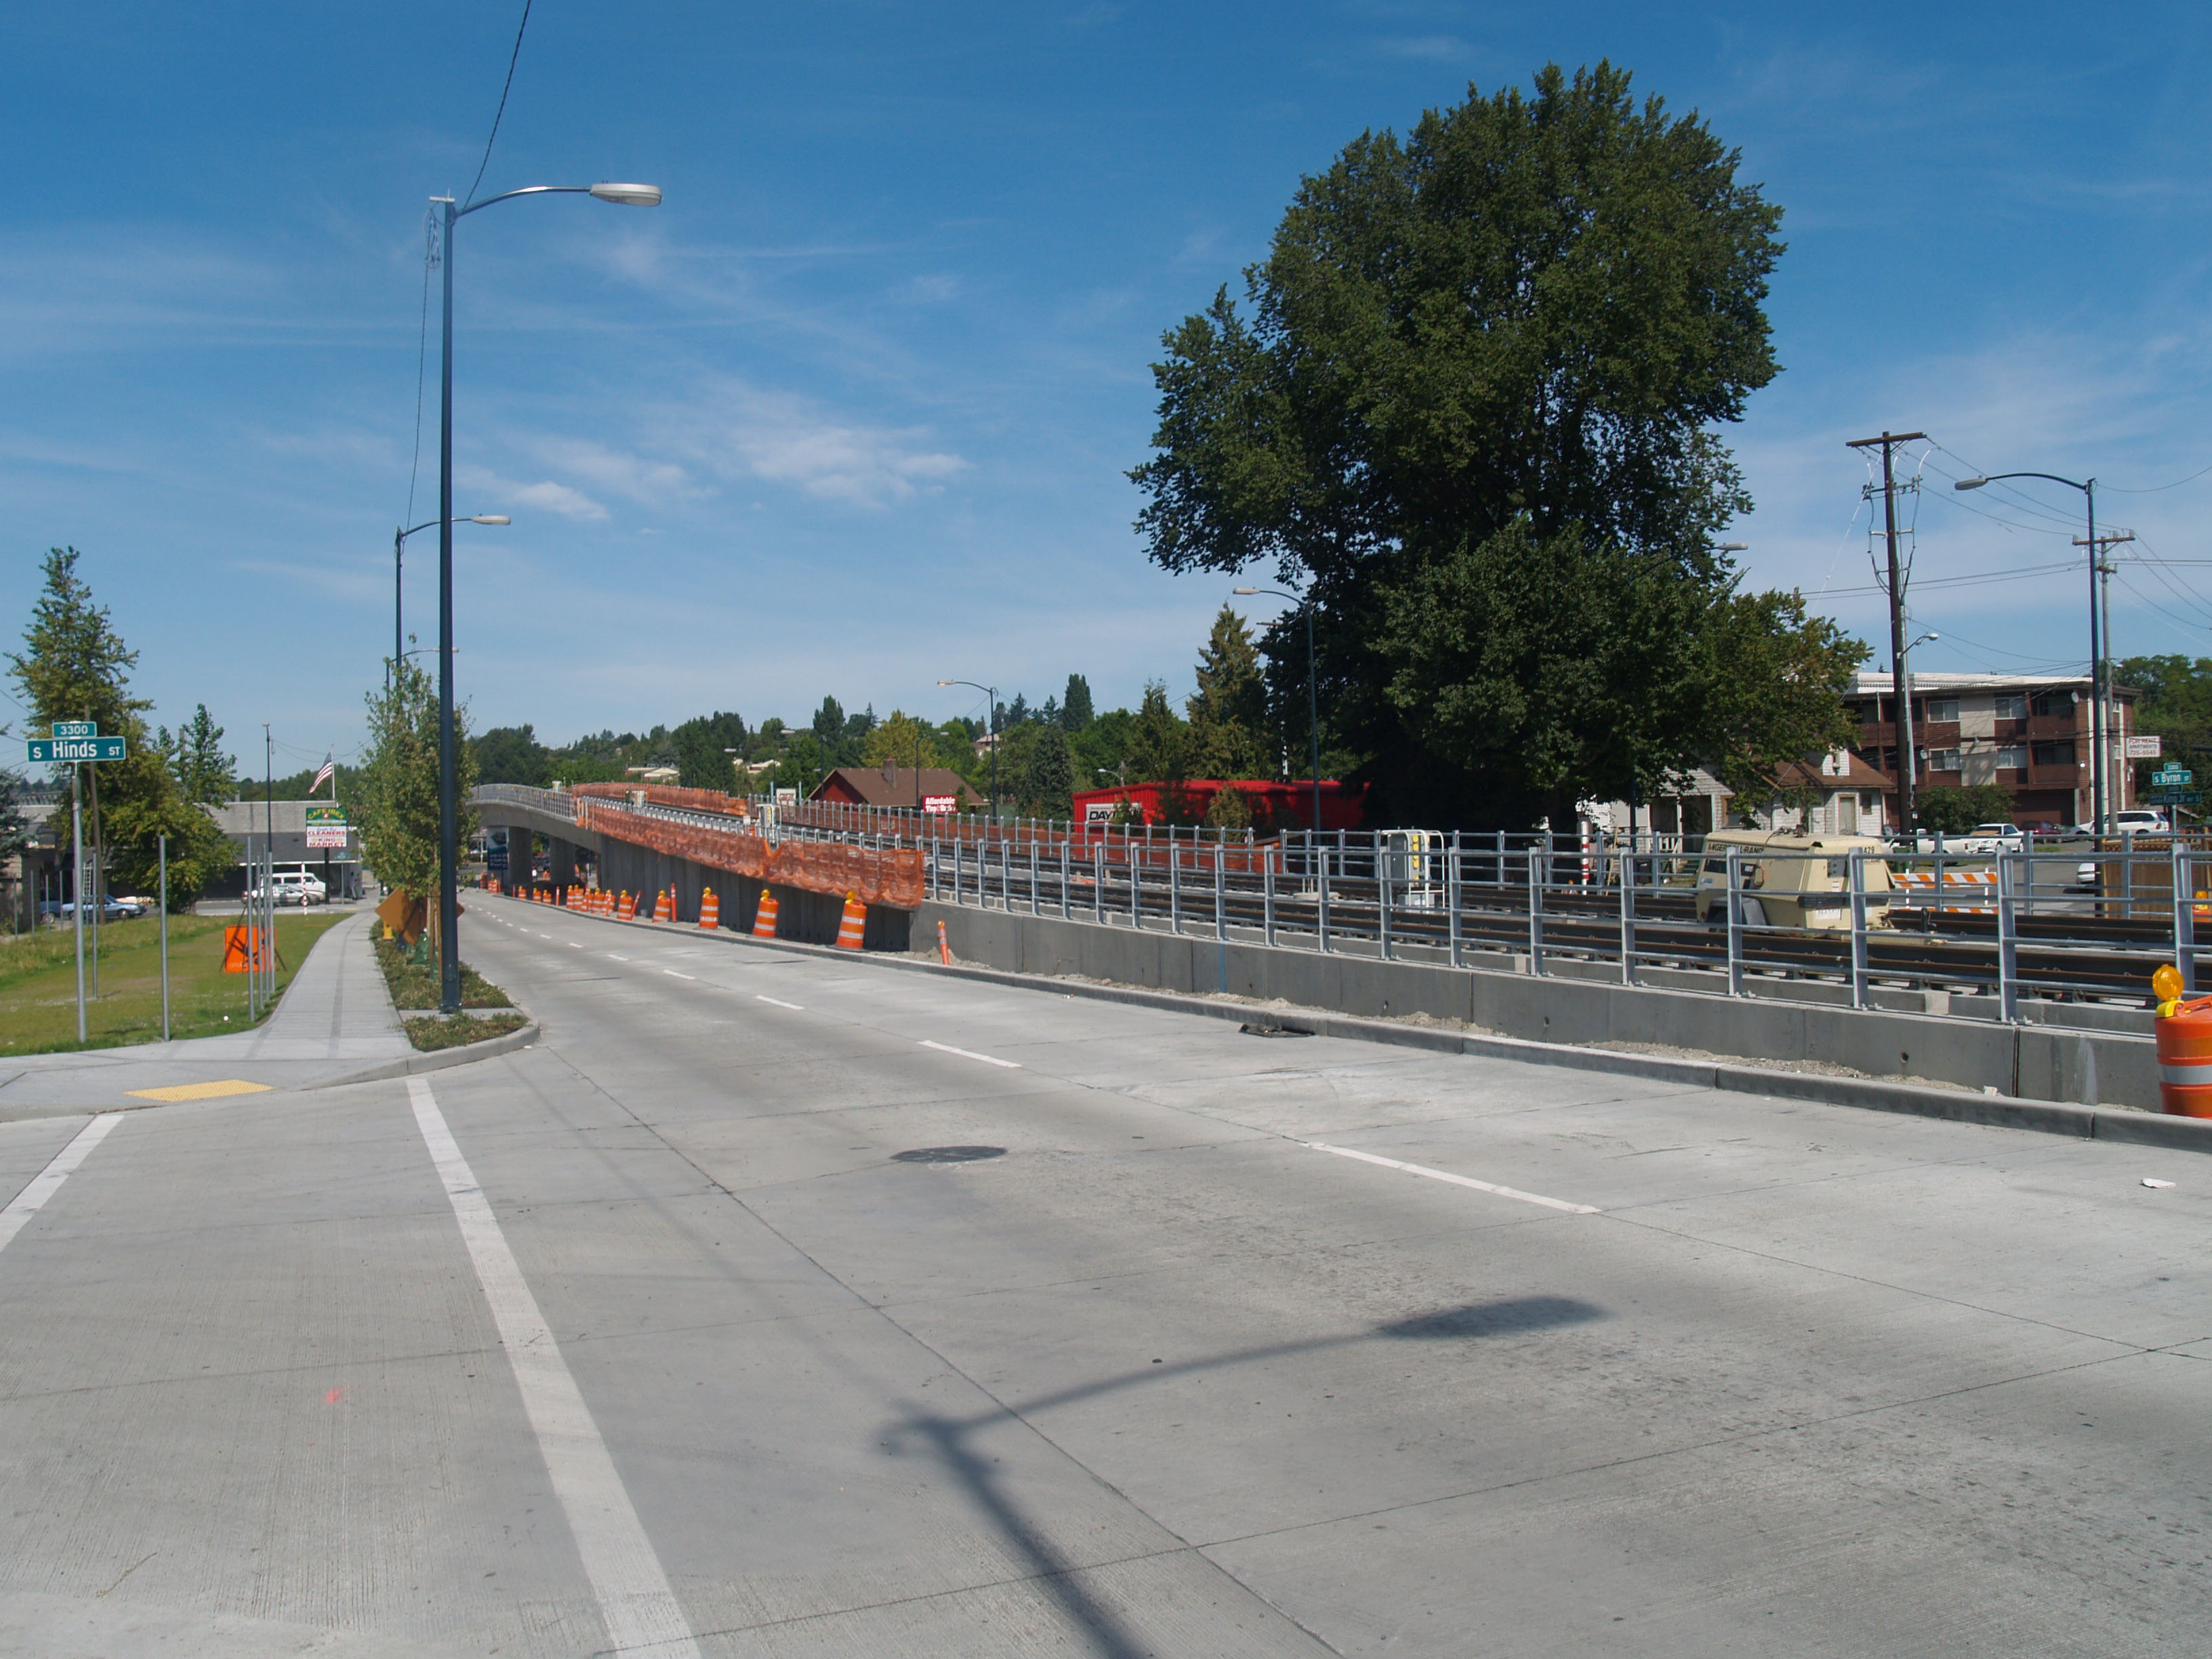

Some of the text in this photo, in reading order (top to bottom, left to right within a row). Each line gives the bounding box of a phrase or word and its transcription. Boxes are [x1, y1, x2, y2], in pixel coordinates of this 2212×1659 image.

[60, 724, 89, 735] 3300
[33, 740, 121, 759] S Hinds ST
[2154, 775, 2160, 783] S
[2160, 773, 2182, 784] Byron
[1864, 846, 1875, 854] 429
